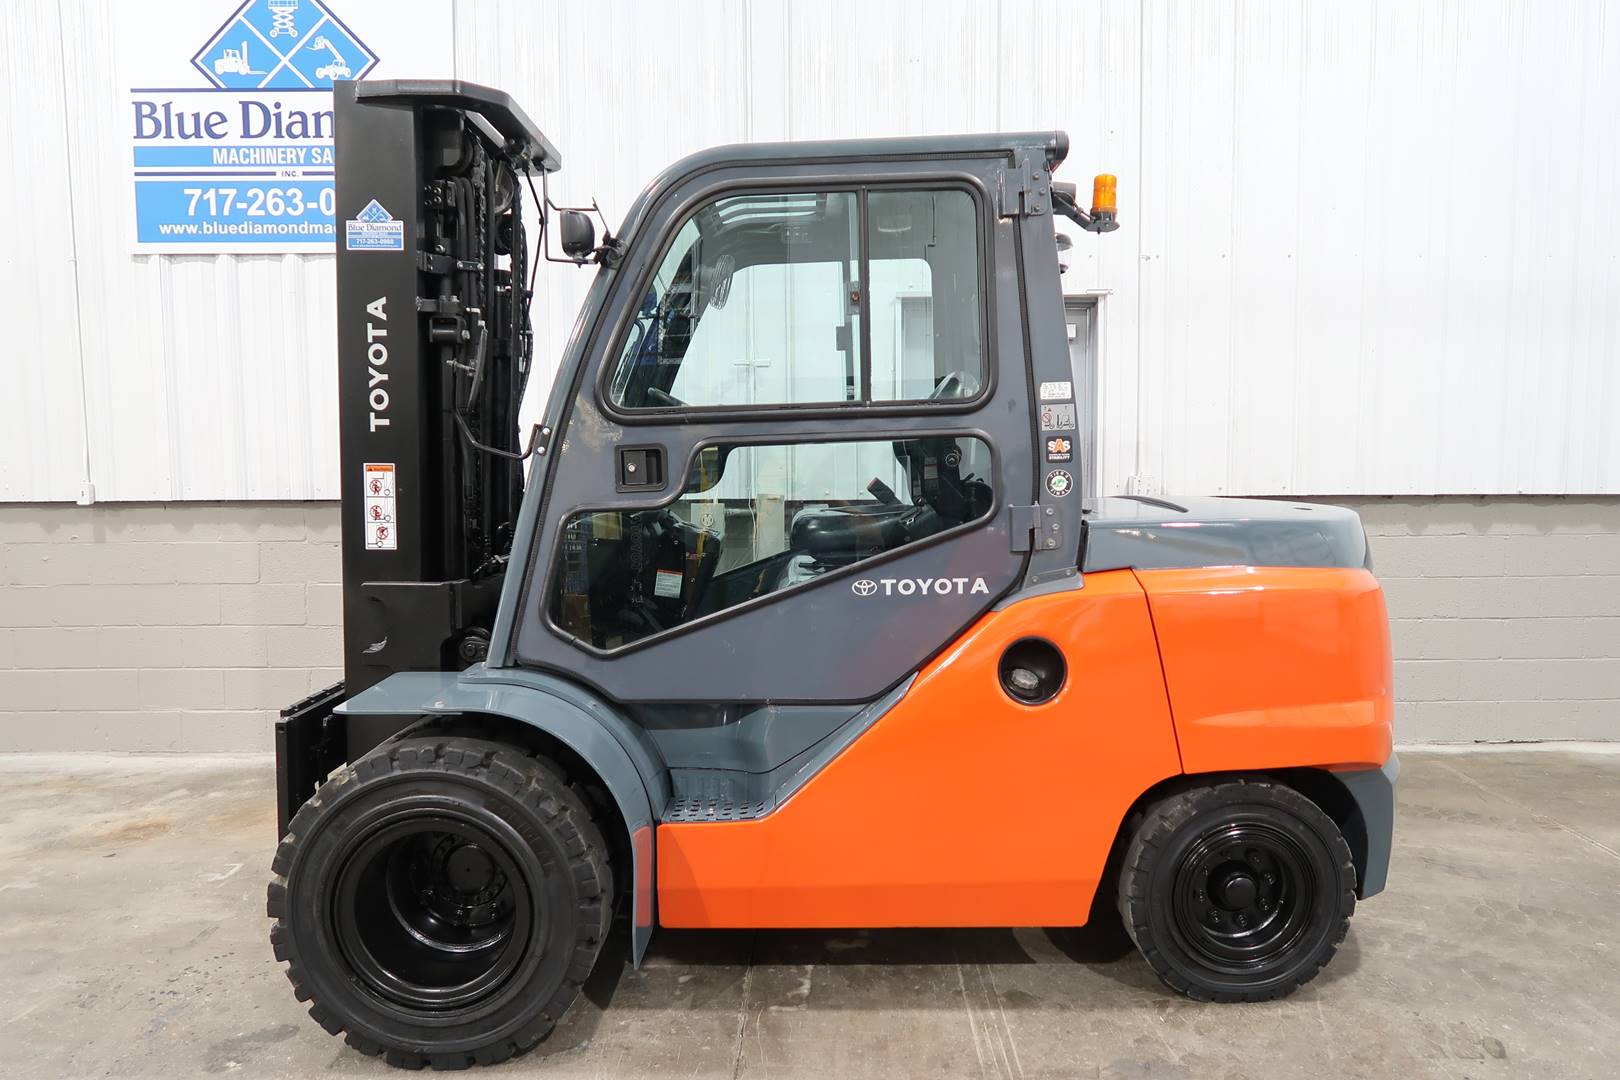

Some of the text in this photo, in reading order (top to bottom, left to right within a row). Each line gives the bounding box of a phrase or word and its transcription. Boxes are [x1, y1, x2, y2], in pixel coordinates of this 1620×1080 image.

[132, 101, 228, 139] Blue
[213, 148, 307, 164] MACHINERY
[159, 221, 336, 235] www.bluediamondma
[348, 224, 401, 232] Blue Diamond
[367, 296, 390, 432] TOYOTA
[1048, 439, 1071, 452] SAS
[880, 578, 990, 596] TOYOTA
